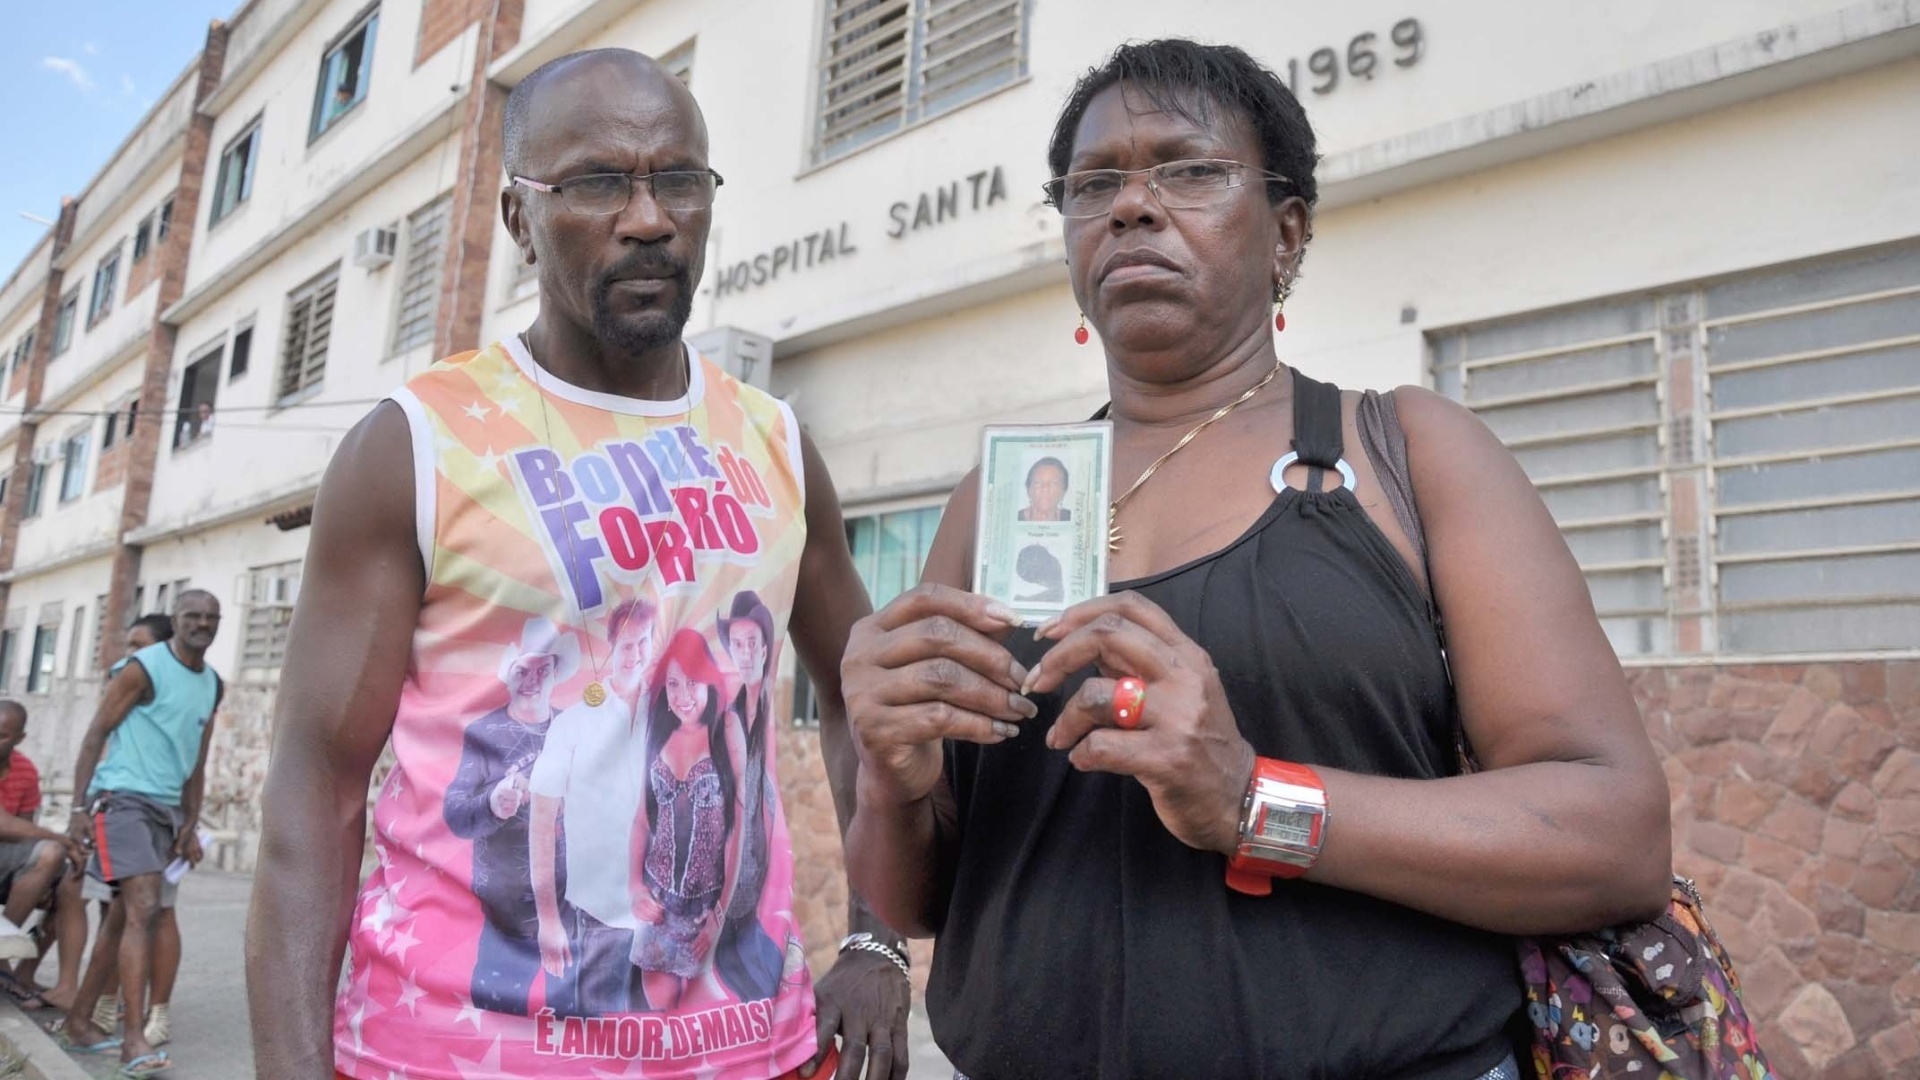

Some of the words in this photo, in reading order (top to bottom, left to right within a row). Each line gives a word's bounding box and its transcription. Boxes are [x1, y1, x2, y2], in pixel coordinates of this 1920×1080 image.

[1287, 17, 1423, 95] 1969
[887, 164, 1007, 239] SANTA
[540, 481, 759, 611] FORRÓ
[534, 1007, 556, 1056] É
[666, 998, 773, 1060] DEMAIS!
